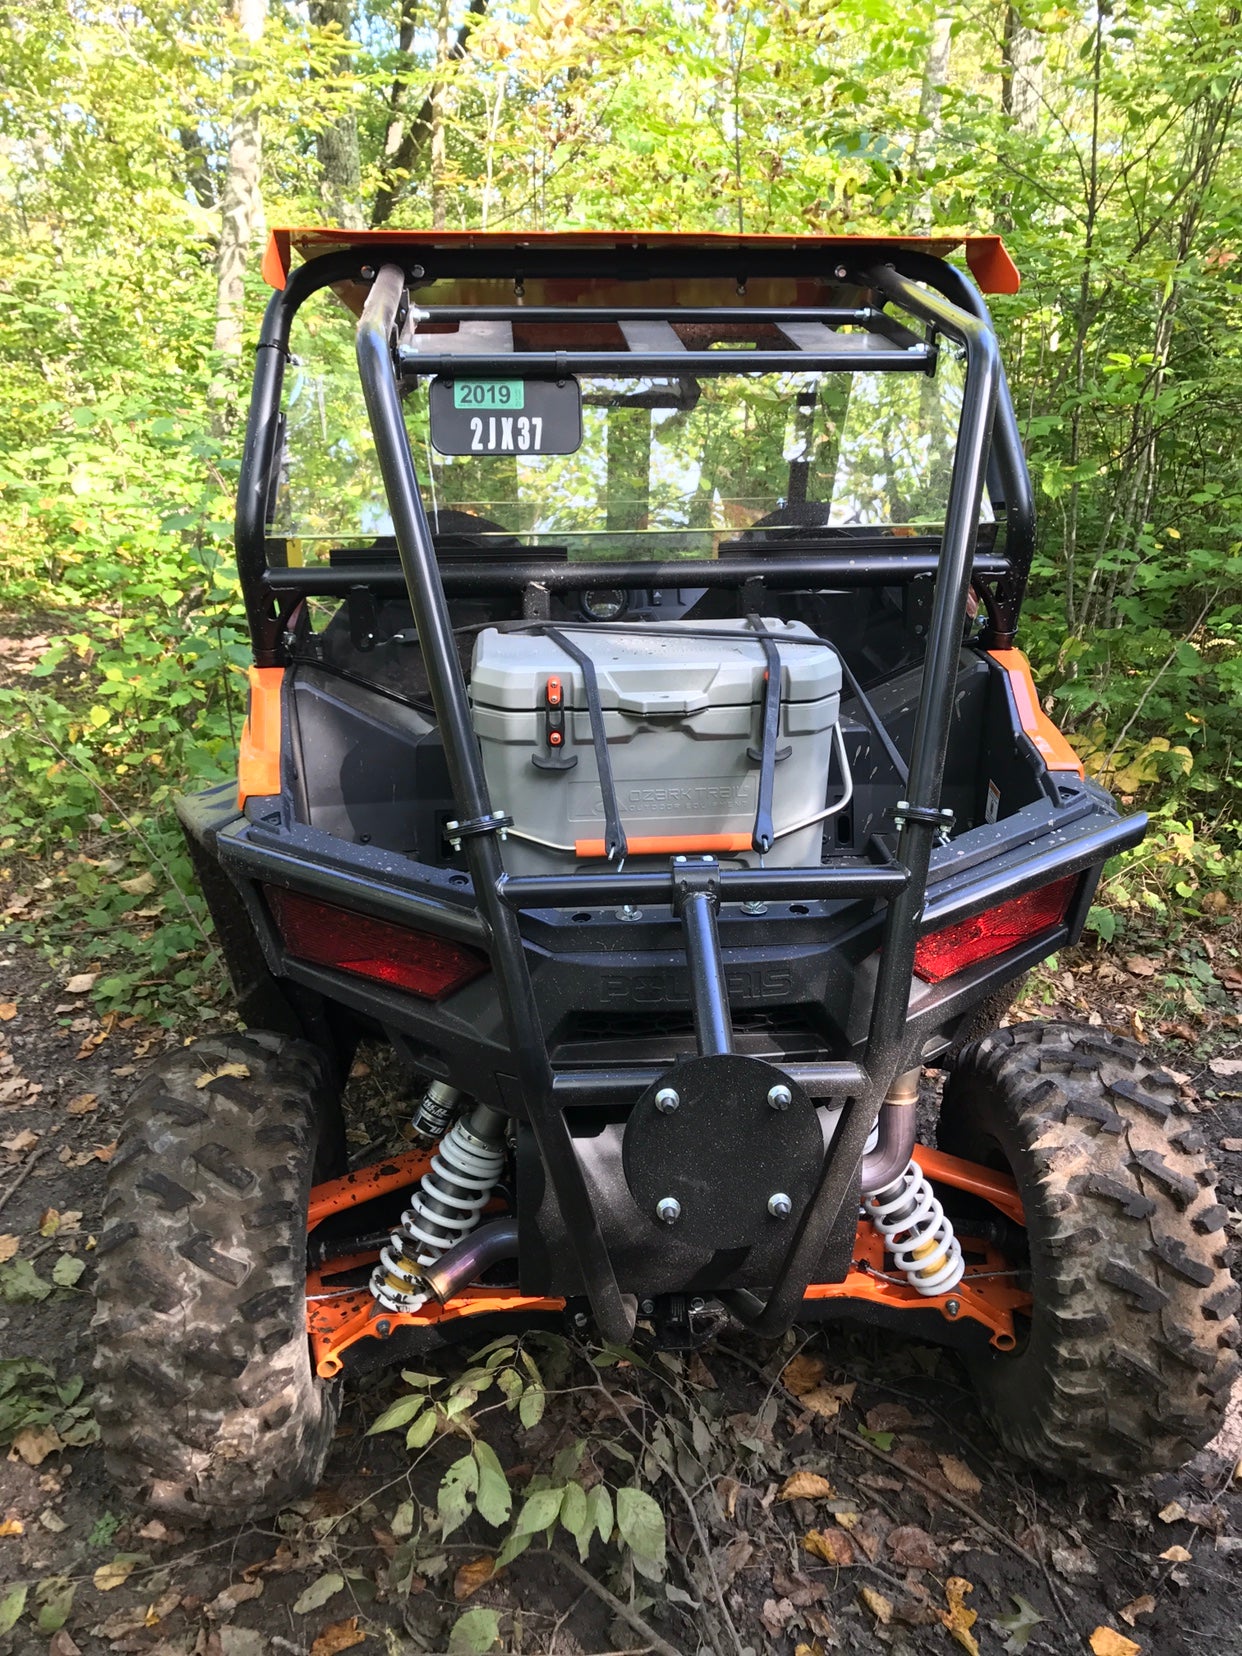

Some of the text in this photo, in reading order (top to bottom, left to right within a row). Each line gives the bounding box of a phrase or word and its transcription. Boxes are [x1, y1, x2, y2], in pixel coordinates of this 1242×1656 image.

[460, 384, 511, 404] 2019
[470, 416, 543, 450] 2JX37
[629, 785, 748, 802] OZARK TRAIL
[599, 968, 794, 1003] POLRIS
